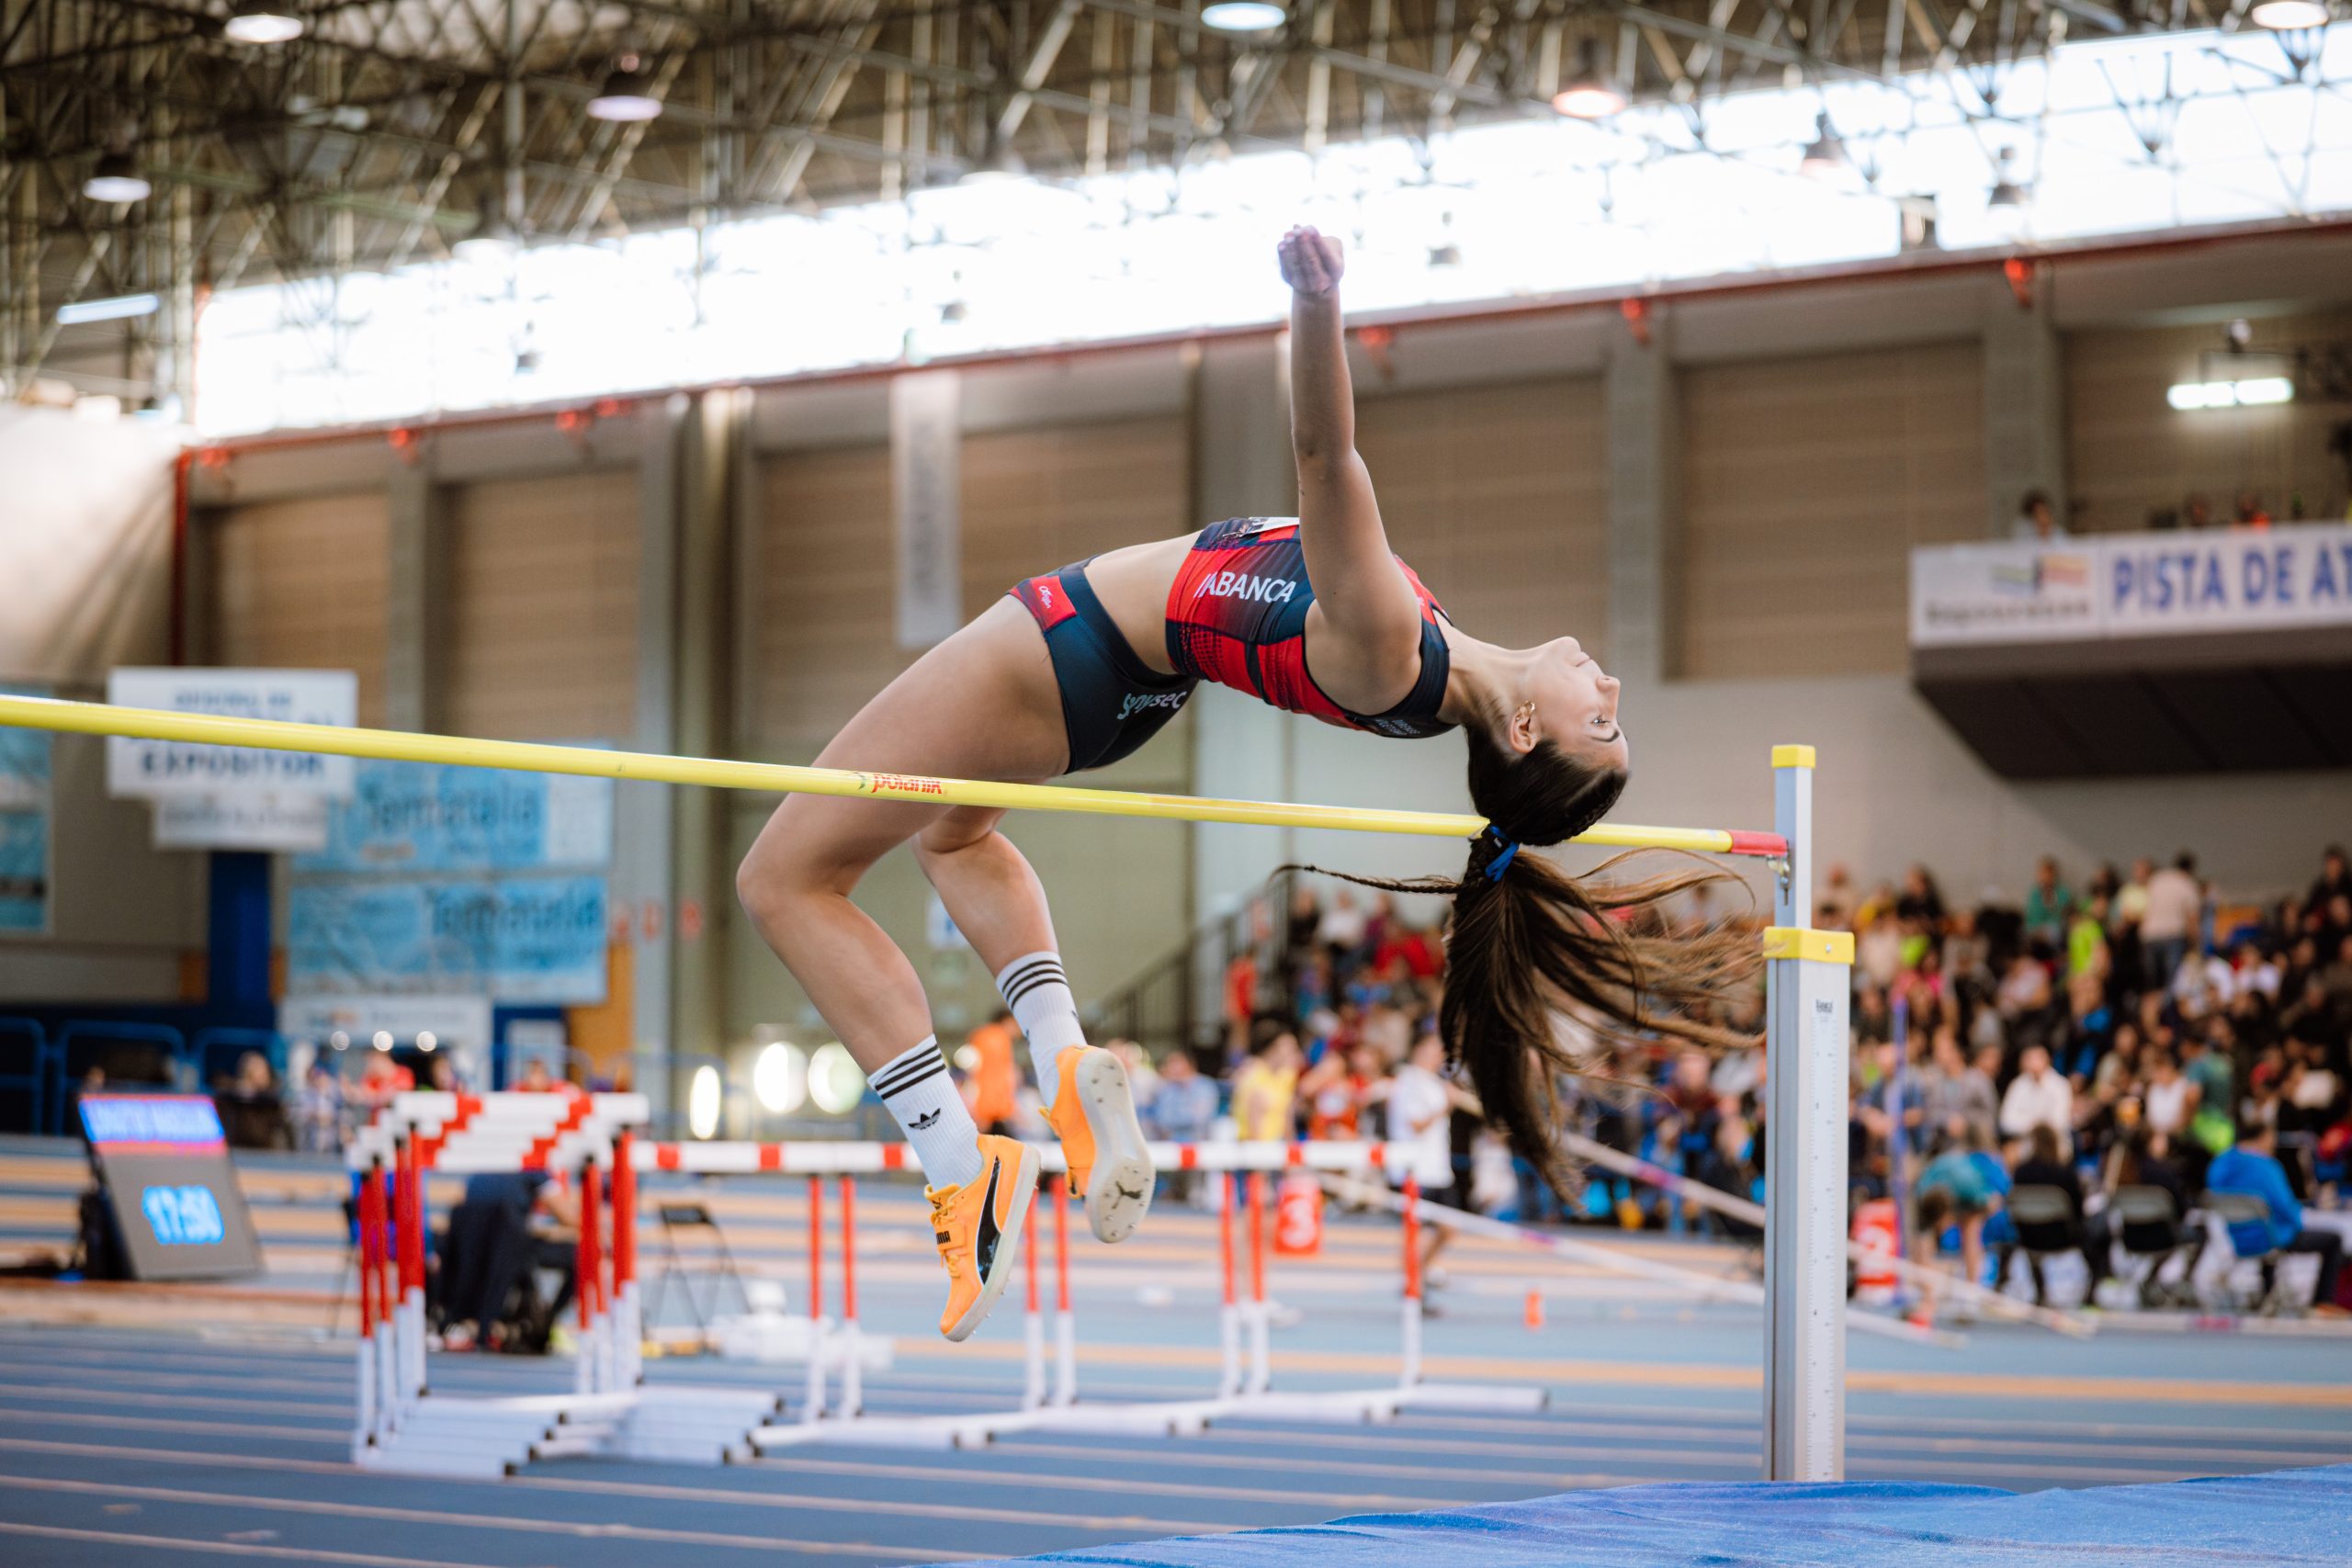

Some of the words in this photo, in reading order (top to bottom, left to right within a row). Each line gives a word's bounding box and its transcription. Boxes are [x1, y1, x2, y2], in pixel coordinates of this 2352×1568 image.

[1193, 571, 1297, 604] ABANCA
[2113, 552, 2227, 612] PISTA
[2243, 547, 2293, 604] DE
[141, 749, 324, 777] EXPOSITOR
[1282, 1195, 1315, 1248] 3
